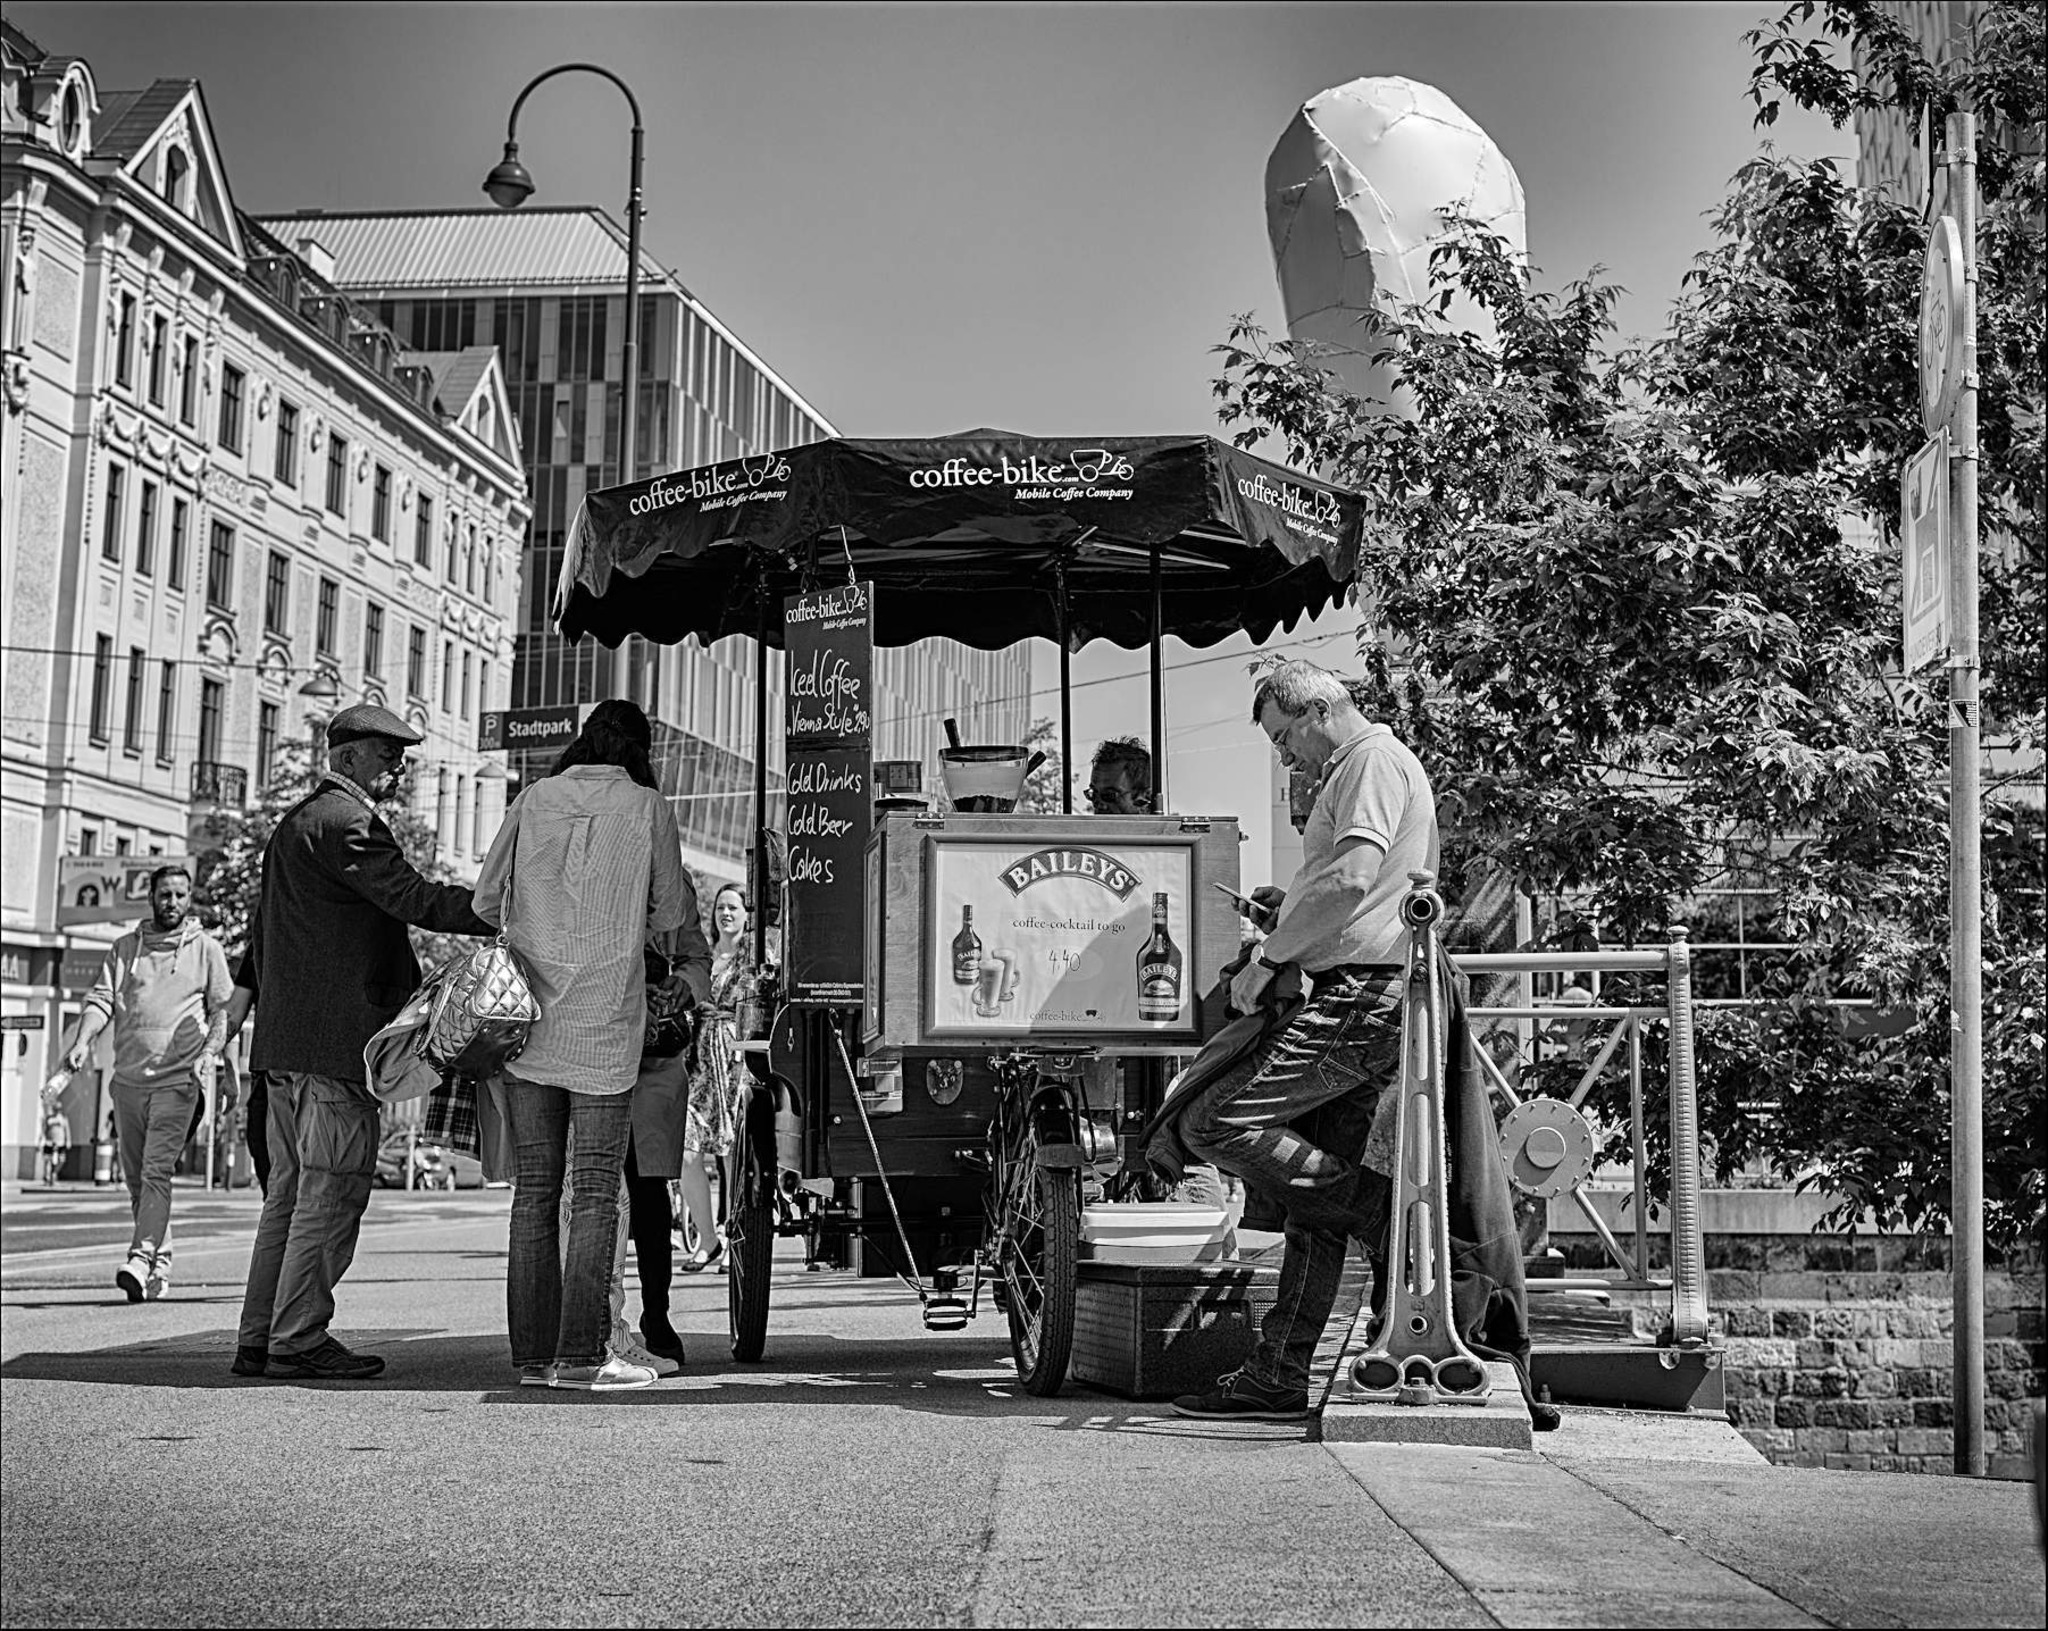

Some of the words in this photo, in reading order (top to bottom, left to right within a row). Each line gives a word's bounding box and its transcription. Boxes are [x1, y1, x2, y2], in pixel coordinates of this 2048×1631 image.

[909, 455, 1062, 488] coffee-bike
[629, 465, 737, 516] coffee-bike
[699, 497, 726, 513] Mobile
[726, 493, 749, 507] Coffee
[748, 490, 788, 501] Company
[1014, 488, 1051, 500] Mobile
[1052, 487, 1085, 501] Coffee
[1086, 486, 1134, 500] Company
[790, 649, 818, 698] Iced
[819, 648, 861, 710] Coffee
[508, 717, 572, 738] Stadtpark
[787, 762, 814, 795] Cold
[816, 762, 862, 794] Drinks
[788, 802, 817, 836] Cold
[818, 805, 853, 838] Beer
[788, 845, 834, 884] Cakes
[1008, 851, 1130, 891] BAILEYS
[1012, 916, 1095, 930] coffee-cocktail
[1097, 921, 1110, 931] to
[1111, 924, 1126, 935] go
